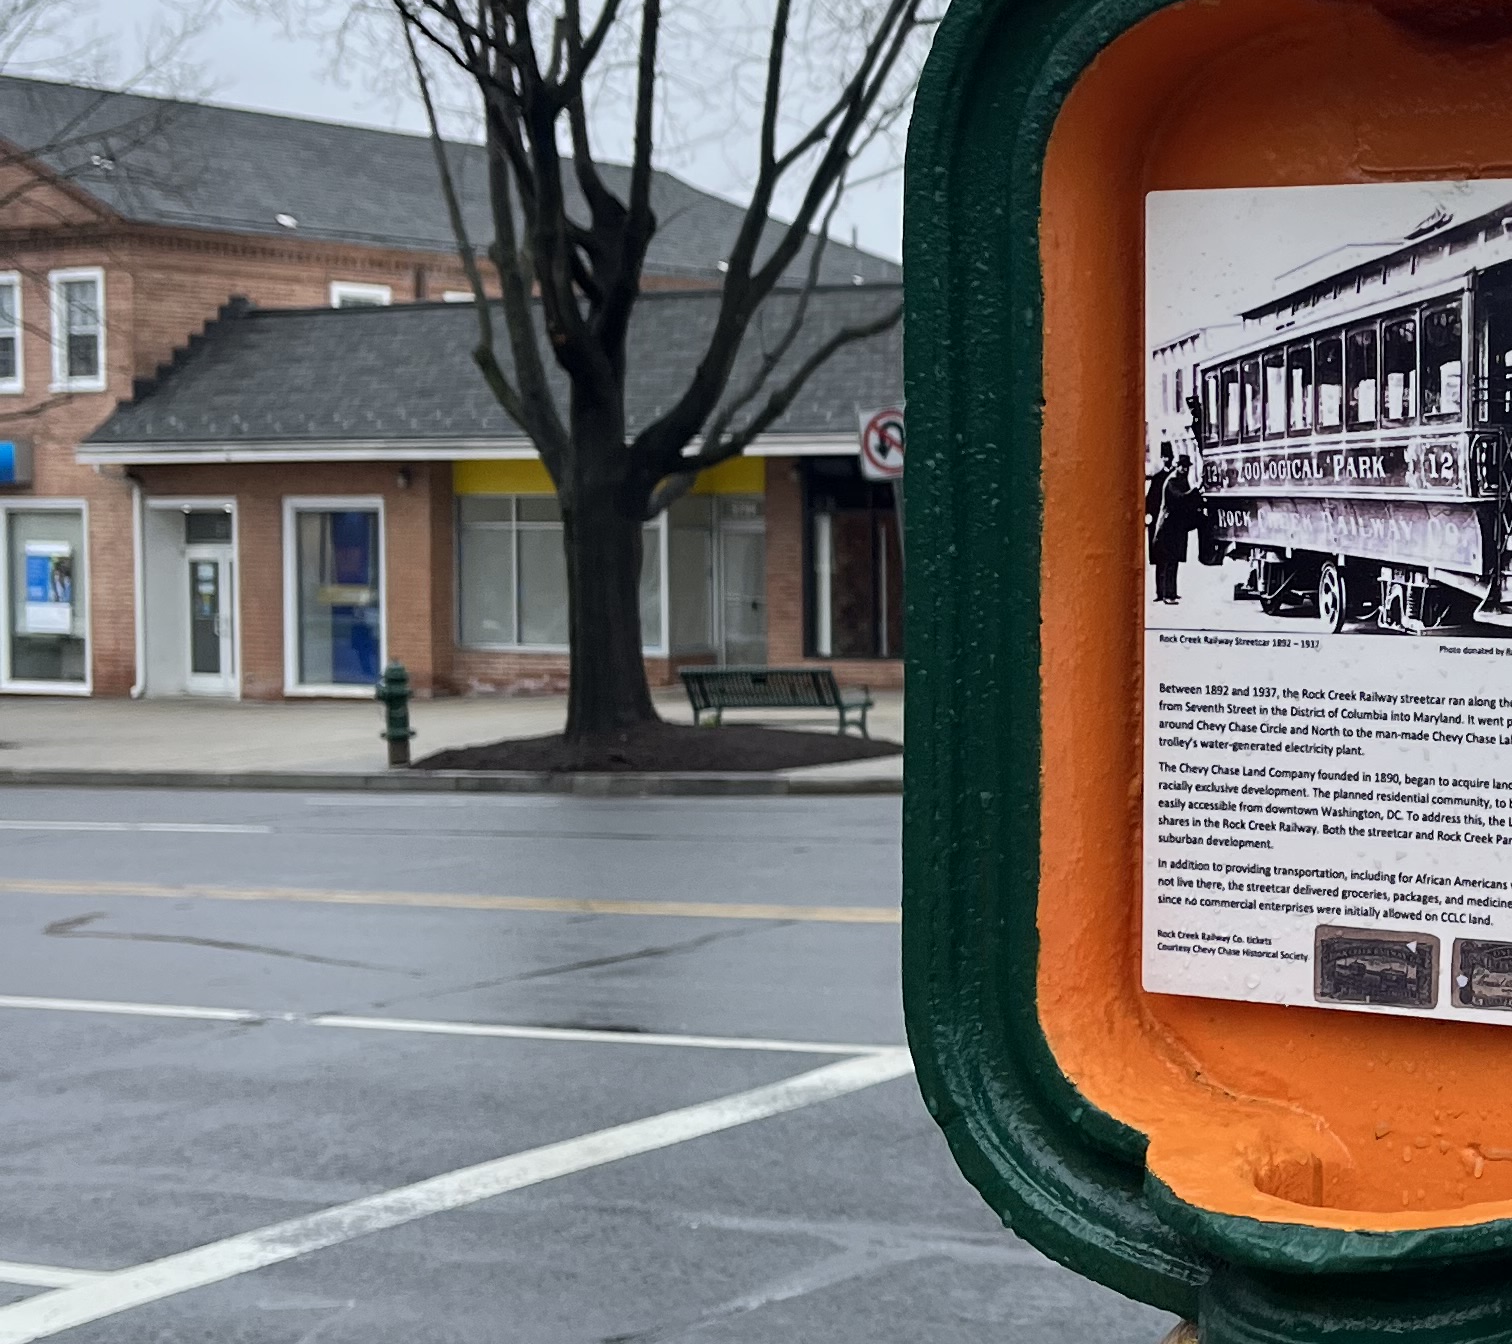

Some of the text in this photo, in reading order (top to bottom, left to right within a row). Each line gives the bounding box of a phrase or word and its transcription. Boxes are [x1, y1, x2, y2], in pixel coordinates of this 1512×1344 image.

[1333, 454, 1387, 482] PARK
[1429, 452, 1454, 480] 12
[1217, 508, 1252, 528] ROCK
[1320, 509, 1414, 543] RAILWAY
[1158, 633, 1178, 644] Rock
[1178, 633, 1202, 644] Creek
[1234, 636, 1270, 647] Streetcar
[1158, 681, 1203, 695] Between
[1204, 683, 1229, 696] 1892
[1230, 684, 1250, 697] and
[1252, 685, 1280, 700] 1937,
[1281, 686, 1300, 700] the
[1300, 687, 1326, 700] Rock
[1326, 688, 1357, 702] Creek
[1358, 690, 1399, 706] Railway
[1399, 693, 1446, 706] streetcar
[1447, 696, 1466, 706] ran
[1467, 694, 1497, 710] along
[1157, 698, 1183, 712] from
[1184, 700, 1225, 714] Seventh
[1225, 702, 1257, 715] Street
[1258, 704, 1269, 716] in
[1269, 704, 1288, 717] the
[1289, 704, 1326, 719] District
[1326, 706, 1339, 719] of
[1339, 707, 1388, 721] Columbia
[1389, 709, 1411, 722] into
[1412, 710, 1465, 726] Maryland.
[1466, 713, 1476, 725] It
[1476, 715, 1505, 727] went
[1157, 735, 1365, 758] trolley's water-generated electricity plant.
[1157, 760, 1177, 773] The
[1178, 761, 1210, 777] Chevy
[1210, 763, 1241, 776] Chase
[1241, 765, 1267, 778] Land
[1267, 766, 1316, 782] Company
[1316, 767, 1360, 782] founded
[1361, 770, 1372, 783] in
[1373, 771, 1402, 786] 1890,
[1403, 772, 1436, 788] began
[1437, 775, 1450, 787] to
[1450, 777, 1490, 791] acquire
[1157, 796, 1186, 812] easily
[1187, 799, 1237, 812] accessible
[1237, 800, 1264, 813] from
[1264, 802, 1319, 817] downtown
[1319, 805, 1384, 821] Washington,
[1385, 808, 1404, 821] DC.
[1405, 809, 1420, 822] To
[1420, 810, 1462, 825] address
[1462, 812, 1486, 828] this,
[1487, 814, 1506, 827] the
[1157, 831, 1274, 850] suburban development.
[1157, 857, 1168, 869] In
[1169, 857, 1210, 872] addition
[1211, 861, 1223, 873] to
[1224, 862, 1272, 878] providing
[1272, 864, 1348, 882] transportation,
[1349, 868, 1397, 885] including
[1397, 870, 1414, 884] for
[1414, 872, 1452, 886] African
[1452, 875, 1508, 891] Americans
[1157, 876, 1175, 887] not
[1175, 875, 1194, 889] live
[1195, 876, 1226, 892] there,
[1226, 878, 1245, 892] the
[1245, 882, 1291, 894] streetcar
[1291, 882, 1340, 898] delivered
[1340, 888, 1391, 902] groceries,
[1392, 890, 1443, 906] packages,
[1443, 893, 1464, 906] and
[1156, 892, 1494, 926] since no commercial enterprises were initially allowed on CCLC land.
[1156, 928, 1176, 939] Rock
[1176, 929, 1200, 940] Creek
[1231, 933, 1245, 944] Co.
[1156, 941, 1309, 963] Courtesy Chevy Chase Historical Society
